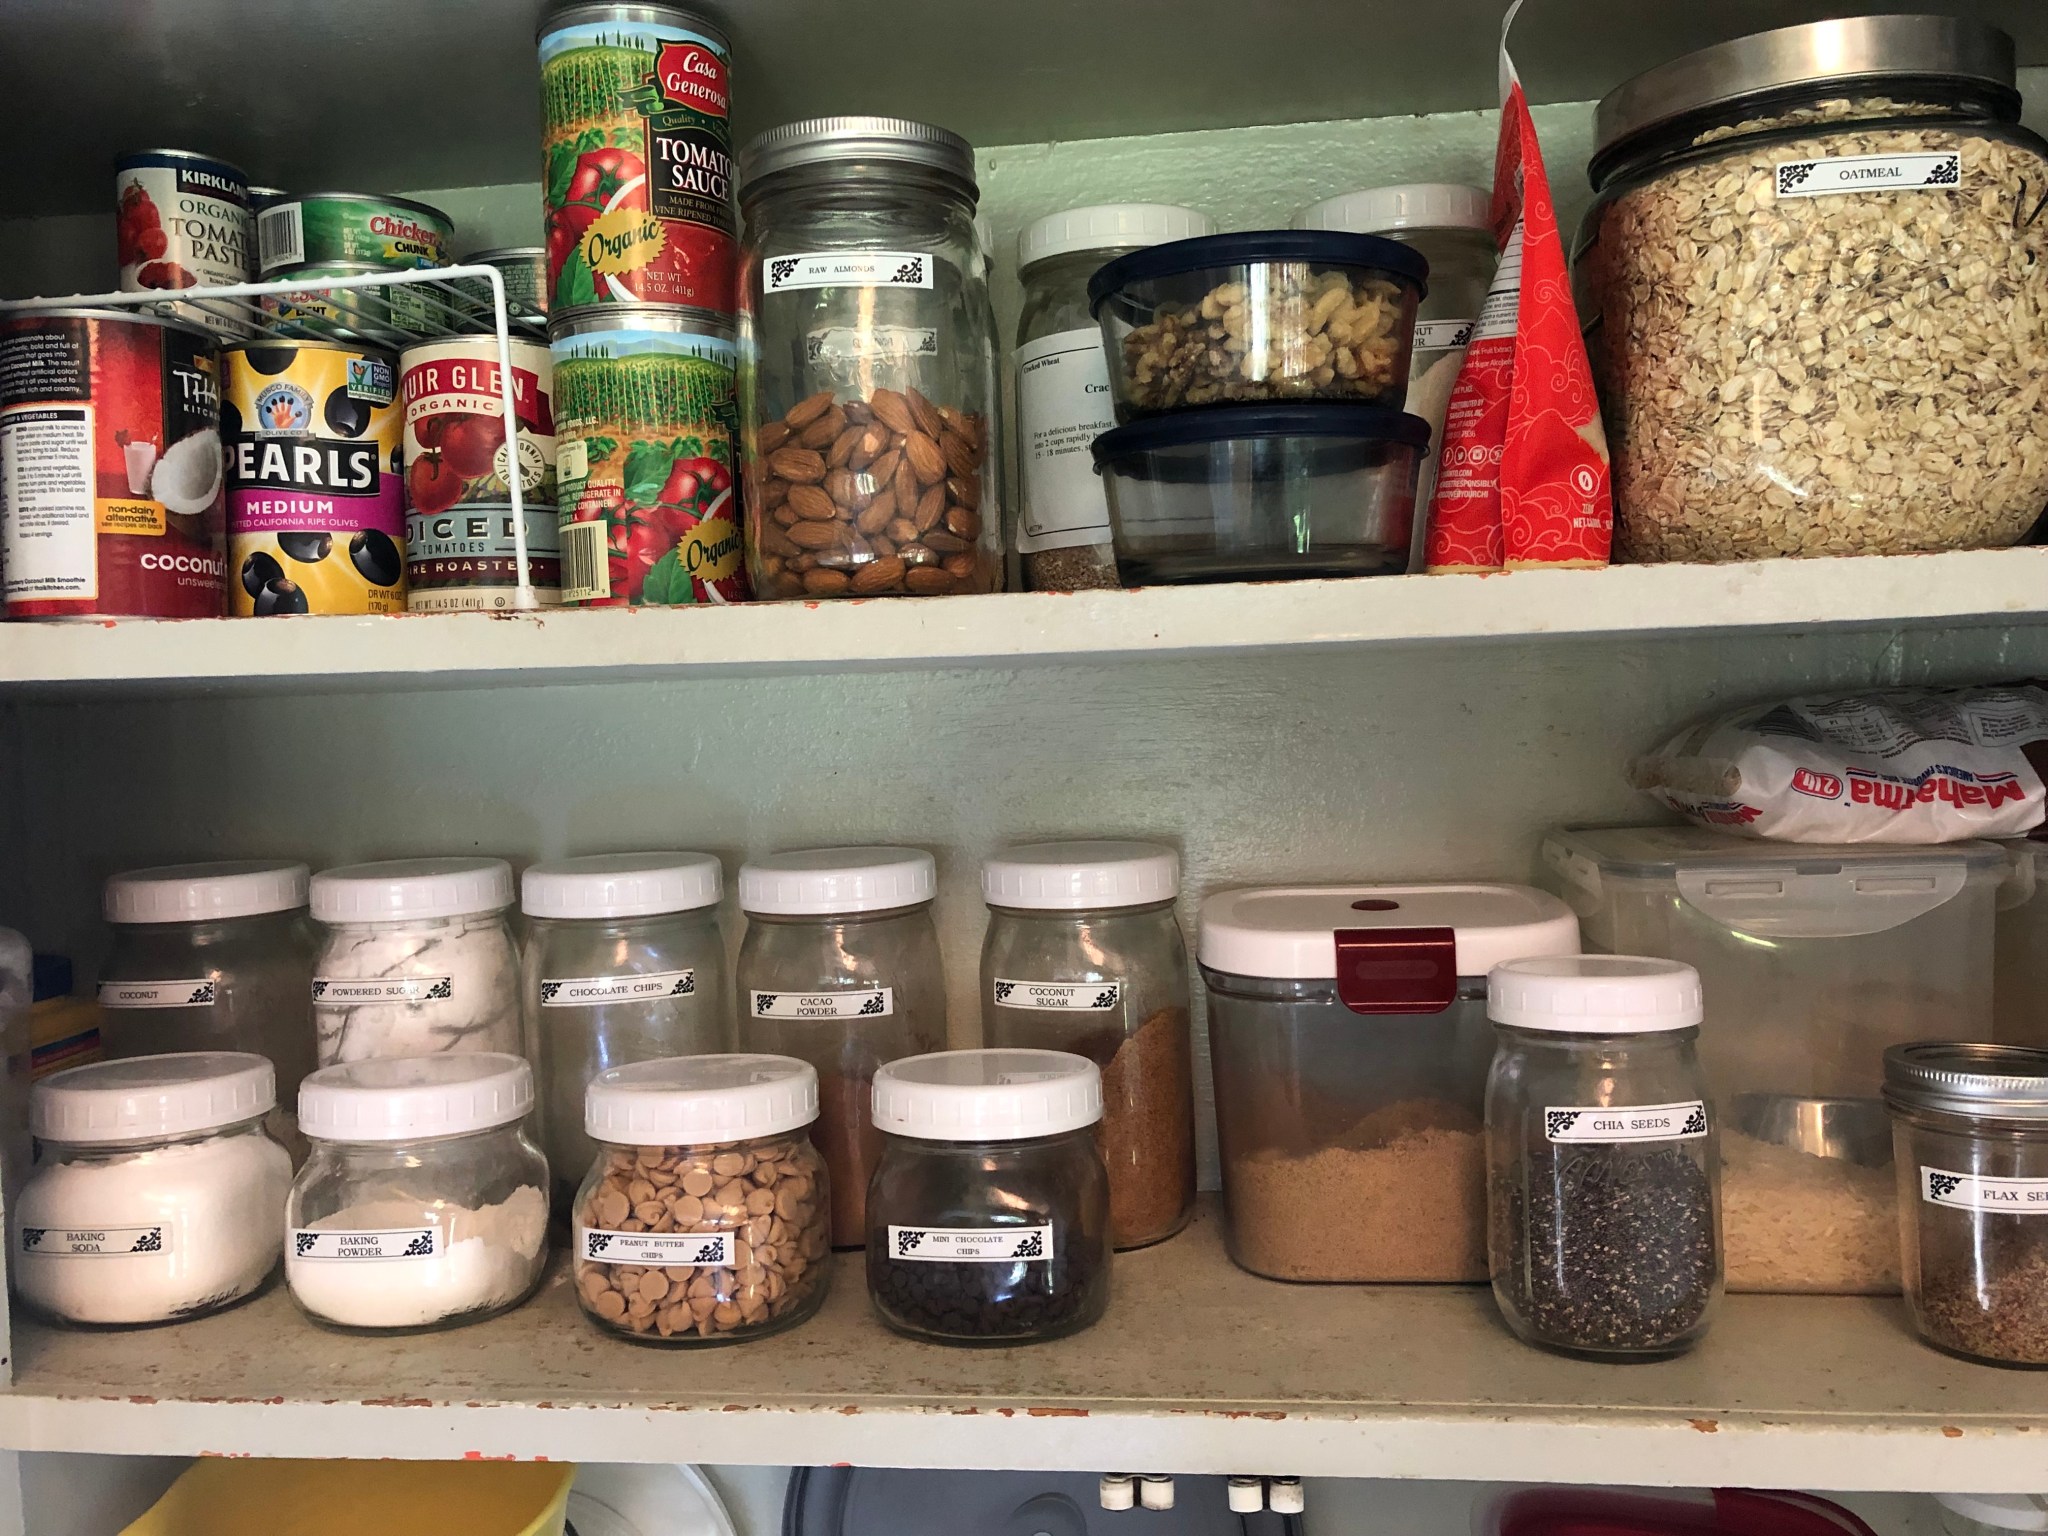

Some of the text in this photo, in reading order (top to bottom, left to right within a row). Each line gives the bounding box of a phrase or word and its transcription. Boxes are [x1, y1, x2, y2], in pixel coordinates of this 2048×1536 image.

[682, 51, 717, 79] Casa
[666, 73, 727, 109] Generosa
[662, 113, 696, 128] Quality
[656, 137, 732, 180] TOMATO
[1839, 167, 1902, 181] OATMEAL
[672, 165, 729, 201] SAUCE
[669, 195, 694, 207] MADE
[654, 205, 676, 215] VINE
[677, 208, 712, 221] RIPENED
[169, 218, 247, 251] TOMAT
[369, 216, 437, 247] Chicken
[588, 218, 659, 267] Organic
[394, 241, 429, 257] CHUNK
[809, 265, 875, 274] RAW ALMONDS
[646, 271, 664, 281] NET
[635, 283, 652, 292] 14.5
[1041, 358, 1060, 369] Wheat
[373, 365, 390, 375] NON
[373, 373, 390, 383] GMO
[452, 365, 524, 401] GLEN
[256, 383, 311, 402] MUSCO FAMILY
[351, 384, 391, 397] VERIFIED
[1085, 383, 1110, 394] Crac
[184, 404, 220, 421] KITCHE
[411, 399, 494, 417] ORGANIC
[1048, 426, 1077, 436] delicious
[1050, 438, 1065, 447] cups
[1066, 433, 1091, 444] rapidly
[499, 469, 541, 489] TOTOES
[587, 478, 616, 488] QUALITY
[613, 488, 621, 497] IN
[108, 505, 155, 517] non-dairy
[246, 500, 334, 515] MEDIUM
[105, 514, 158, 524] alternative
[253, 518, 305, 527] CALIFORNIA
[329, 520, 359, 528] OLIVES
[423, 541, 485, 555] TOMATOES
[687, 528, 740, 572] Organic
[141, 553, 224, 577] coconut
[408, 560, 533, 575] IRE ROASTE
[368, 590, 378, 598] DR
[380, 590, 390, 599] WT
[436, 599, 448, 608] 14.5
[450, 598, 459, 608] OZ
[462, 597, 484, 609] (411g)
[119, 991, 159, 999] COCONUT
[332, 987, 381, 996] POWDERED
[569, 982, 663, 997] CHOCOLATE CHIPS
[1029, 987, 1075, 997] COCONUT
[800, 998, 833, 1006] CACAO
[1036, 998, 1069, 1006] SUGAR
[796, 1007, 838, 1016] POWDER
[1593, 1118, 1671, 1131] CHIA SEEDS
[1983, 1190, 2019, 1201] FLAX
[66, 1233, 105, 1241] BAKING
[340, 1236, 379, 1245] BAKING
[71, 1243, 101, 1252] SODA
[620, 1239, 685, 1248] PEANUT BUTTER
[338, 1247, 382, 1257] POWDER
